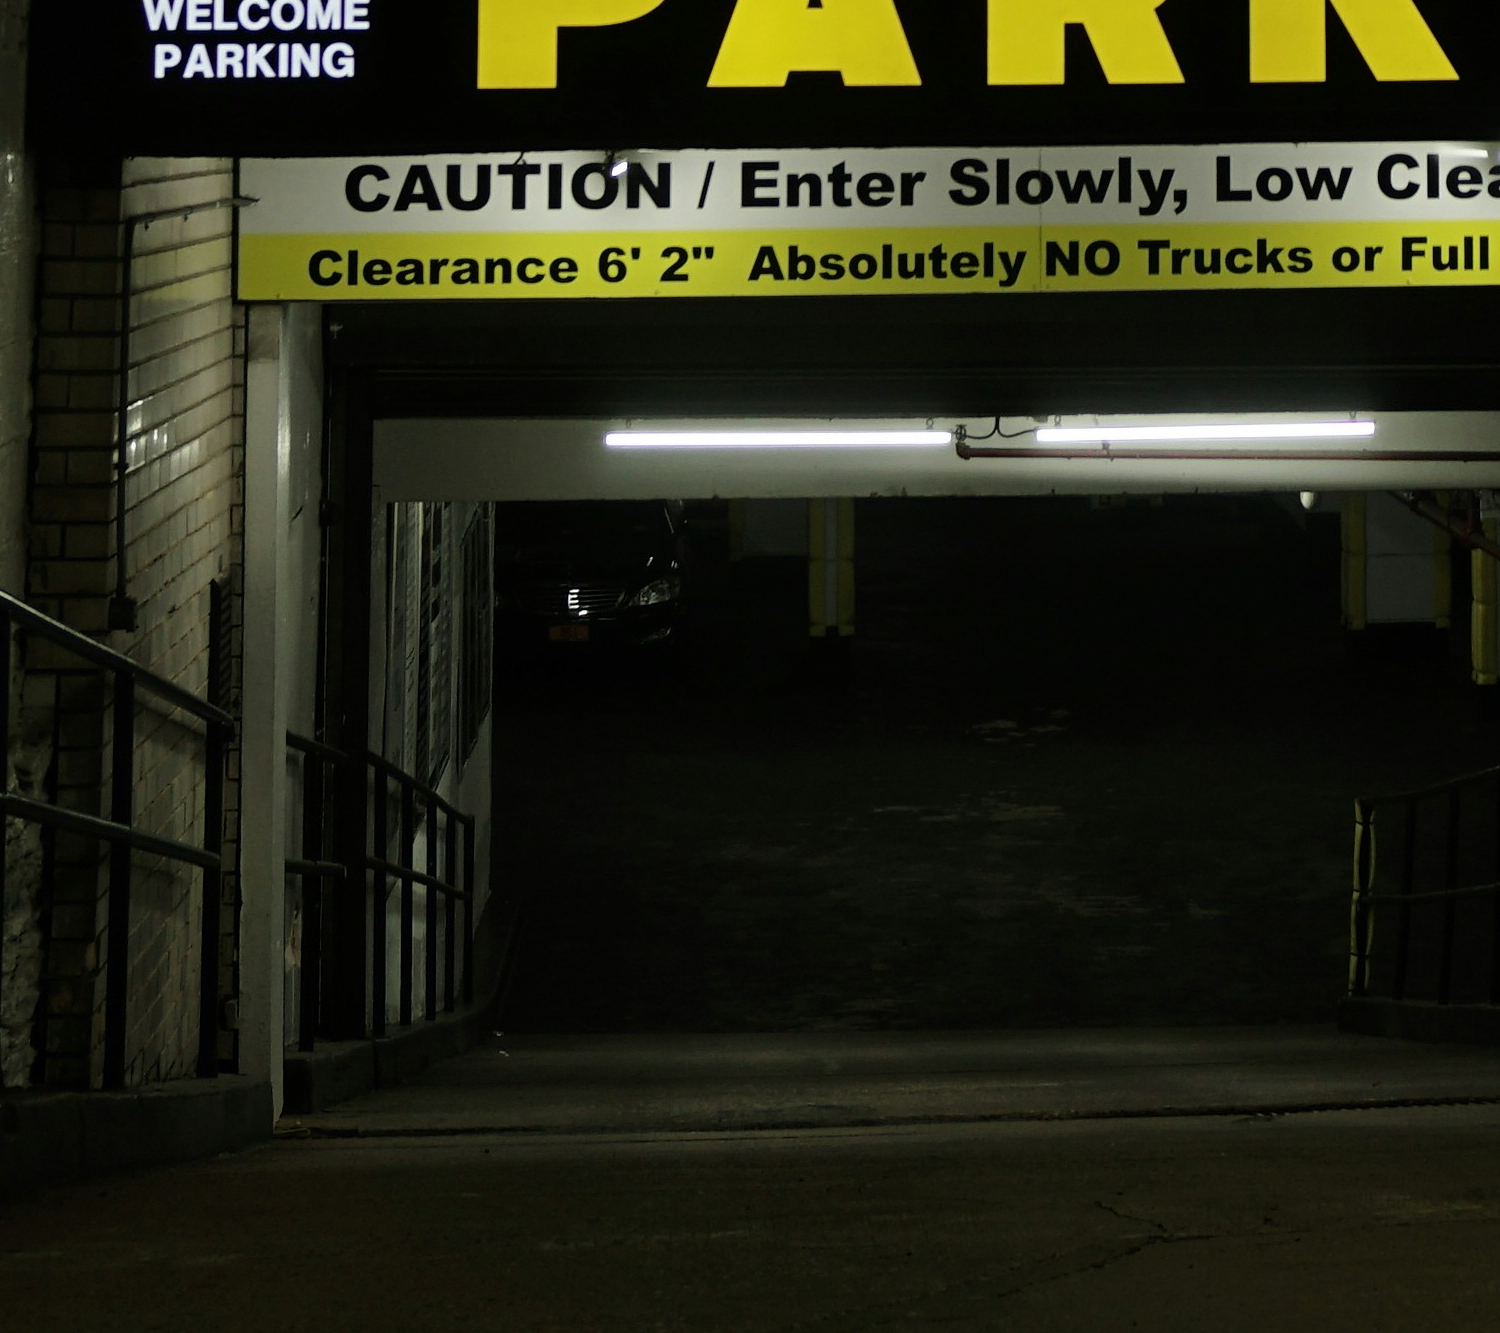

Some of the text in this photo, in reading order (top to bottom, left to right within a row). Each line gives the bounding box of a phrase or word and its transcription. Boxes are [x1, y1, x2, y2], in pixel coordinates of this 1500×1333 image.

[155, 43, 354, 78] PARKING
[345, 159, 670, 212] CAUTION
[698, 162, 714, 208] /
[742, 161, 927, 207] Enter
[949, 157, 1187, 216] Slowly,
[1216, 156, 1352, 202] Low
[308, 250, 578, 286] Clearance
[599, 248, 640, 282] 6'
[660, 247, 714, 281] 2"
[748, 242, 1027, 287] Absolutely
[1046, 240, 1120, 276] NO
[1139, 241, 1312, 277] Trucks
[1332, 247, 1383, 272] or
[1402, 236, 1489, 271] Full
